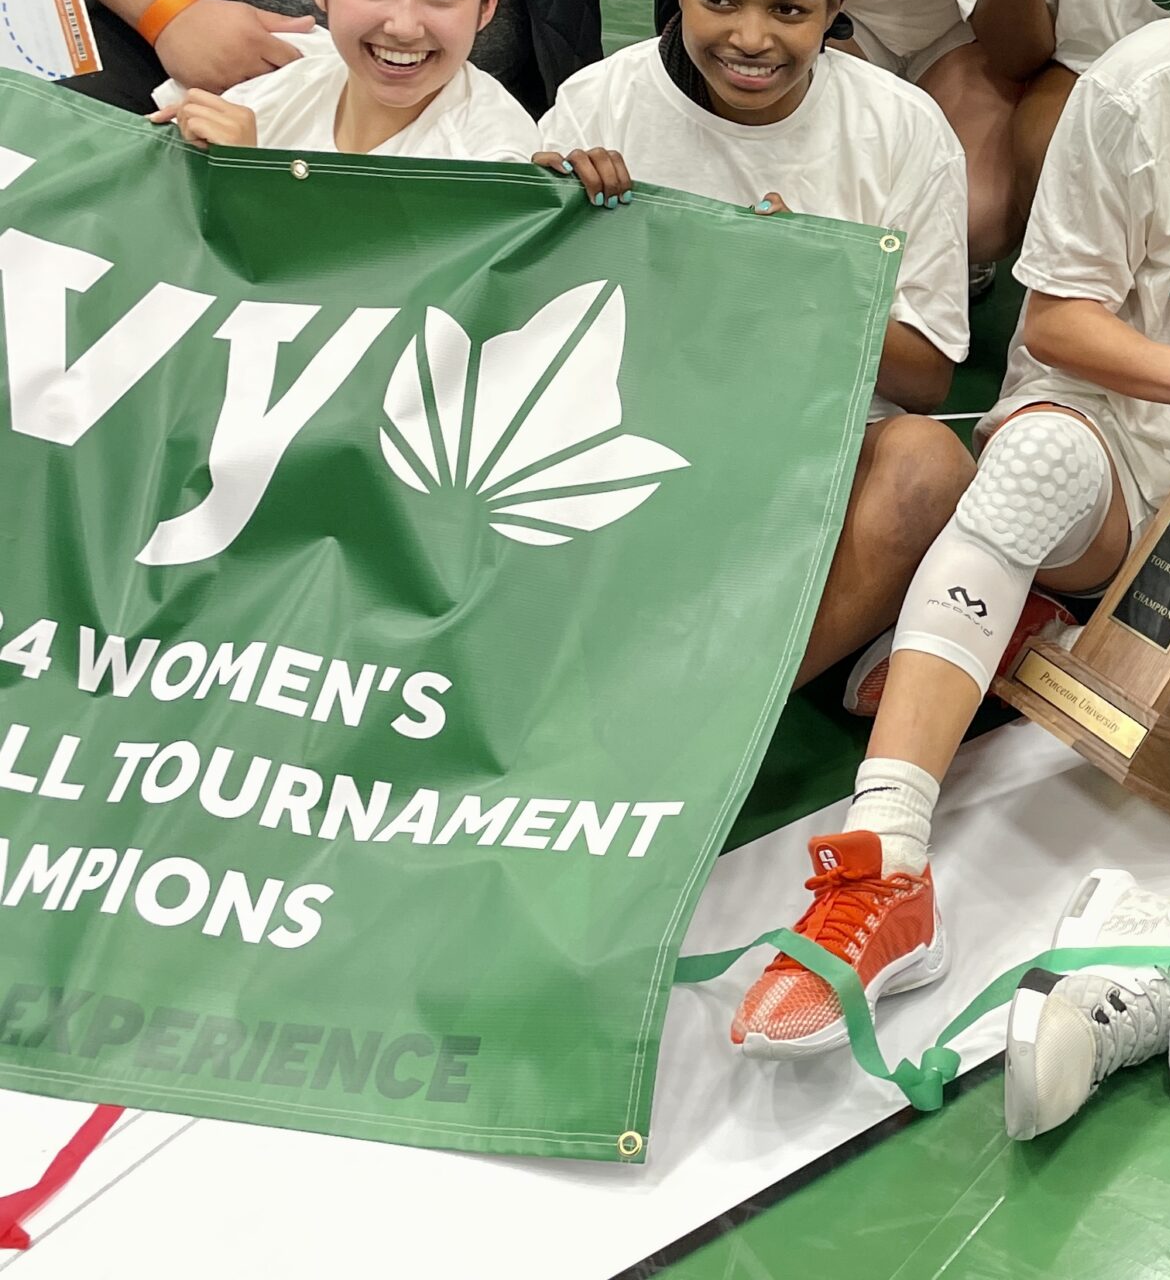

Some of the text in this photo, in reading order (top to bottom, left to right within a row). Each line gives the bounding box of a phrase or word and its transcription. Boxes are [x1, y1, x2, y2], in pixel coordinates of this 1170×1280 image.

[0, 145, 402, 566] vy
[78, 625, 453, 740] WOMEN'S
[1040, 671, 1121, 734] Princeton University
[107, 740, 685, 858] TOURNAMENT
[0, 837, 334, 949] MPIONS
[0, 983, 482, 1103] EXPERIENCE
